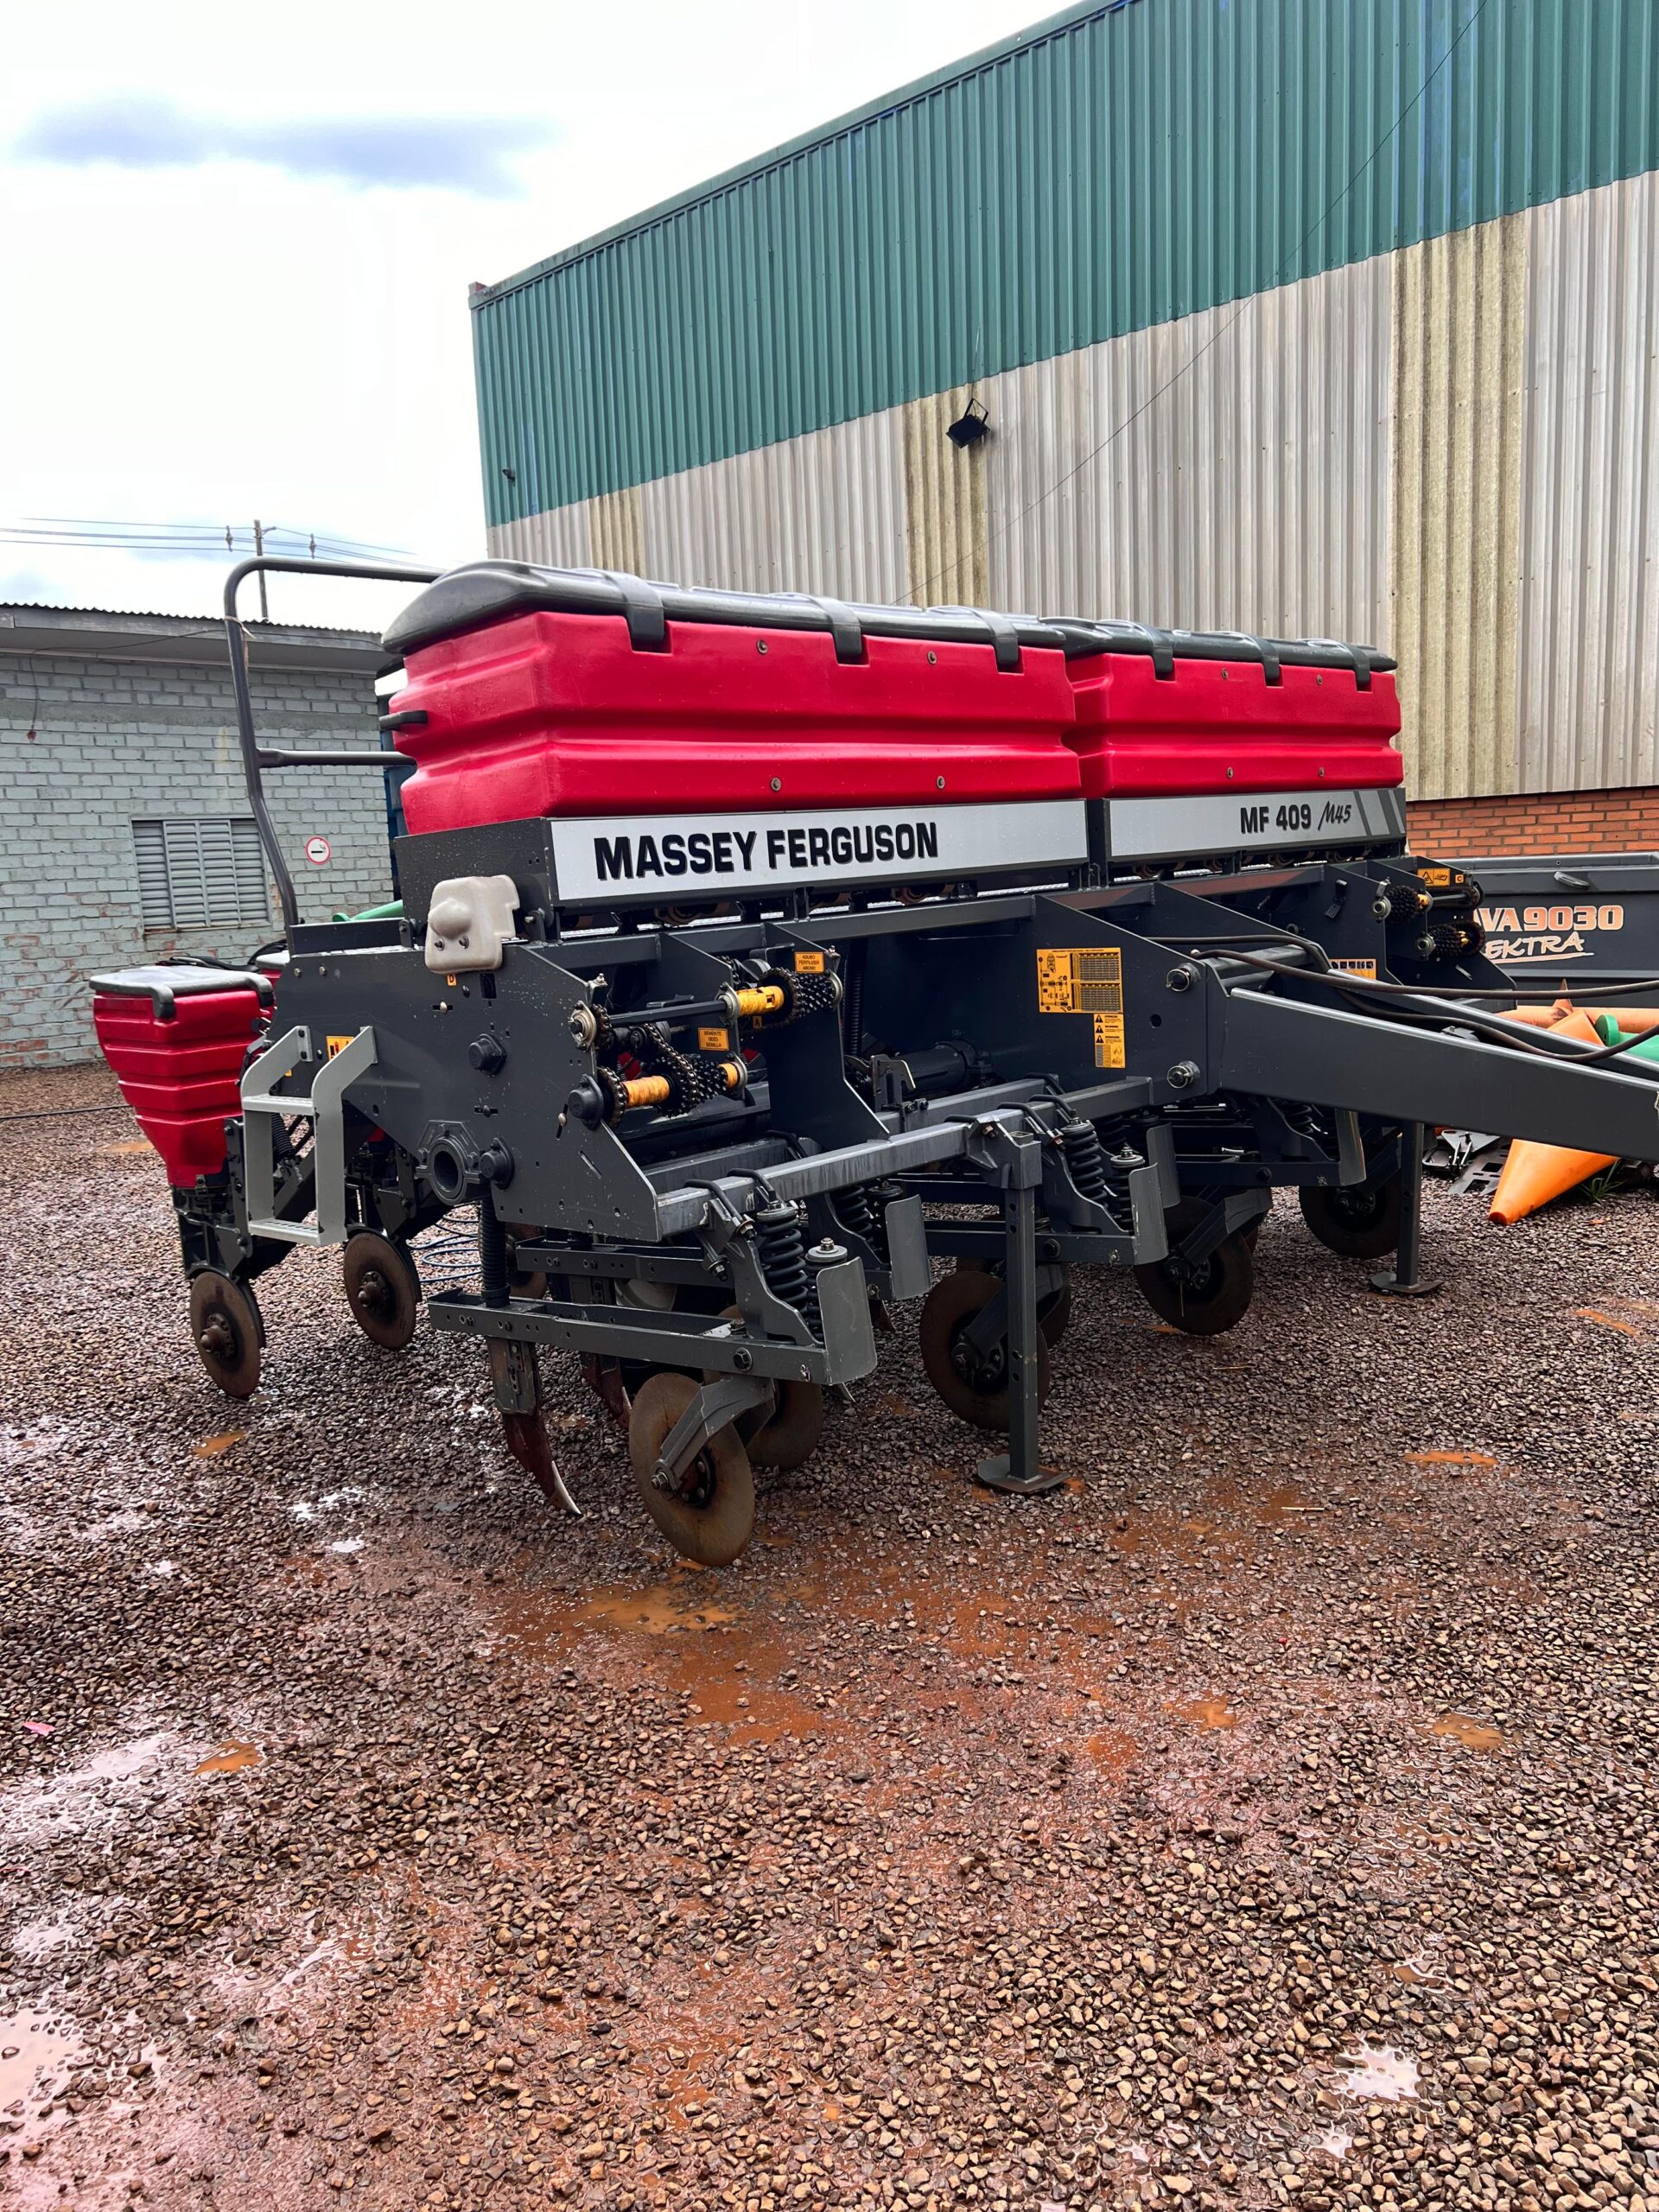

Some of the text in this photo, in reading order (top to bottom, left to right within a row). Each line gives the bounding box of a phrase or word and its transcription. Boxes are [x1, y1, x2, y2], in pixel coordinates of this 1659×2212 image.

[1240, 806, 1269, 835] MF
[1276, 804, 1312, 831] 409
[594, 822, 939, 881] MASSEY FERGUSON
